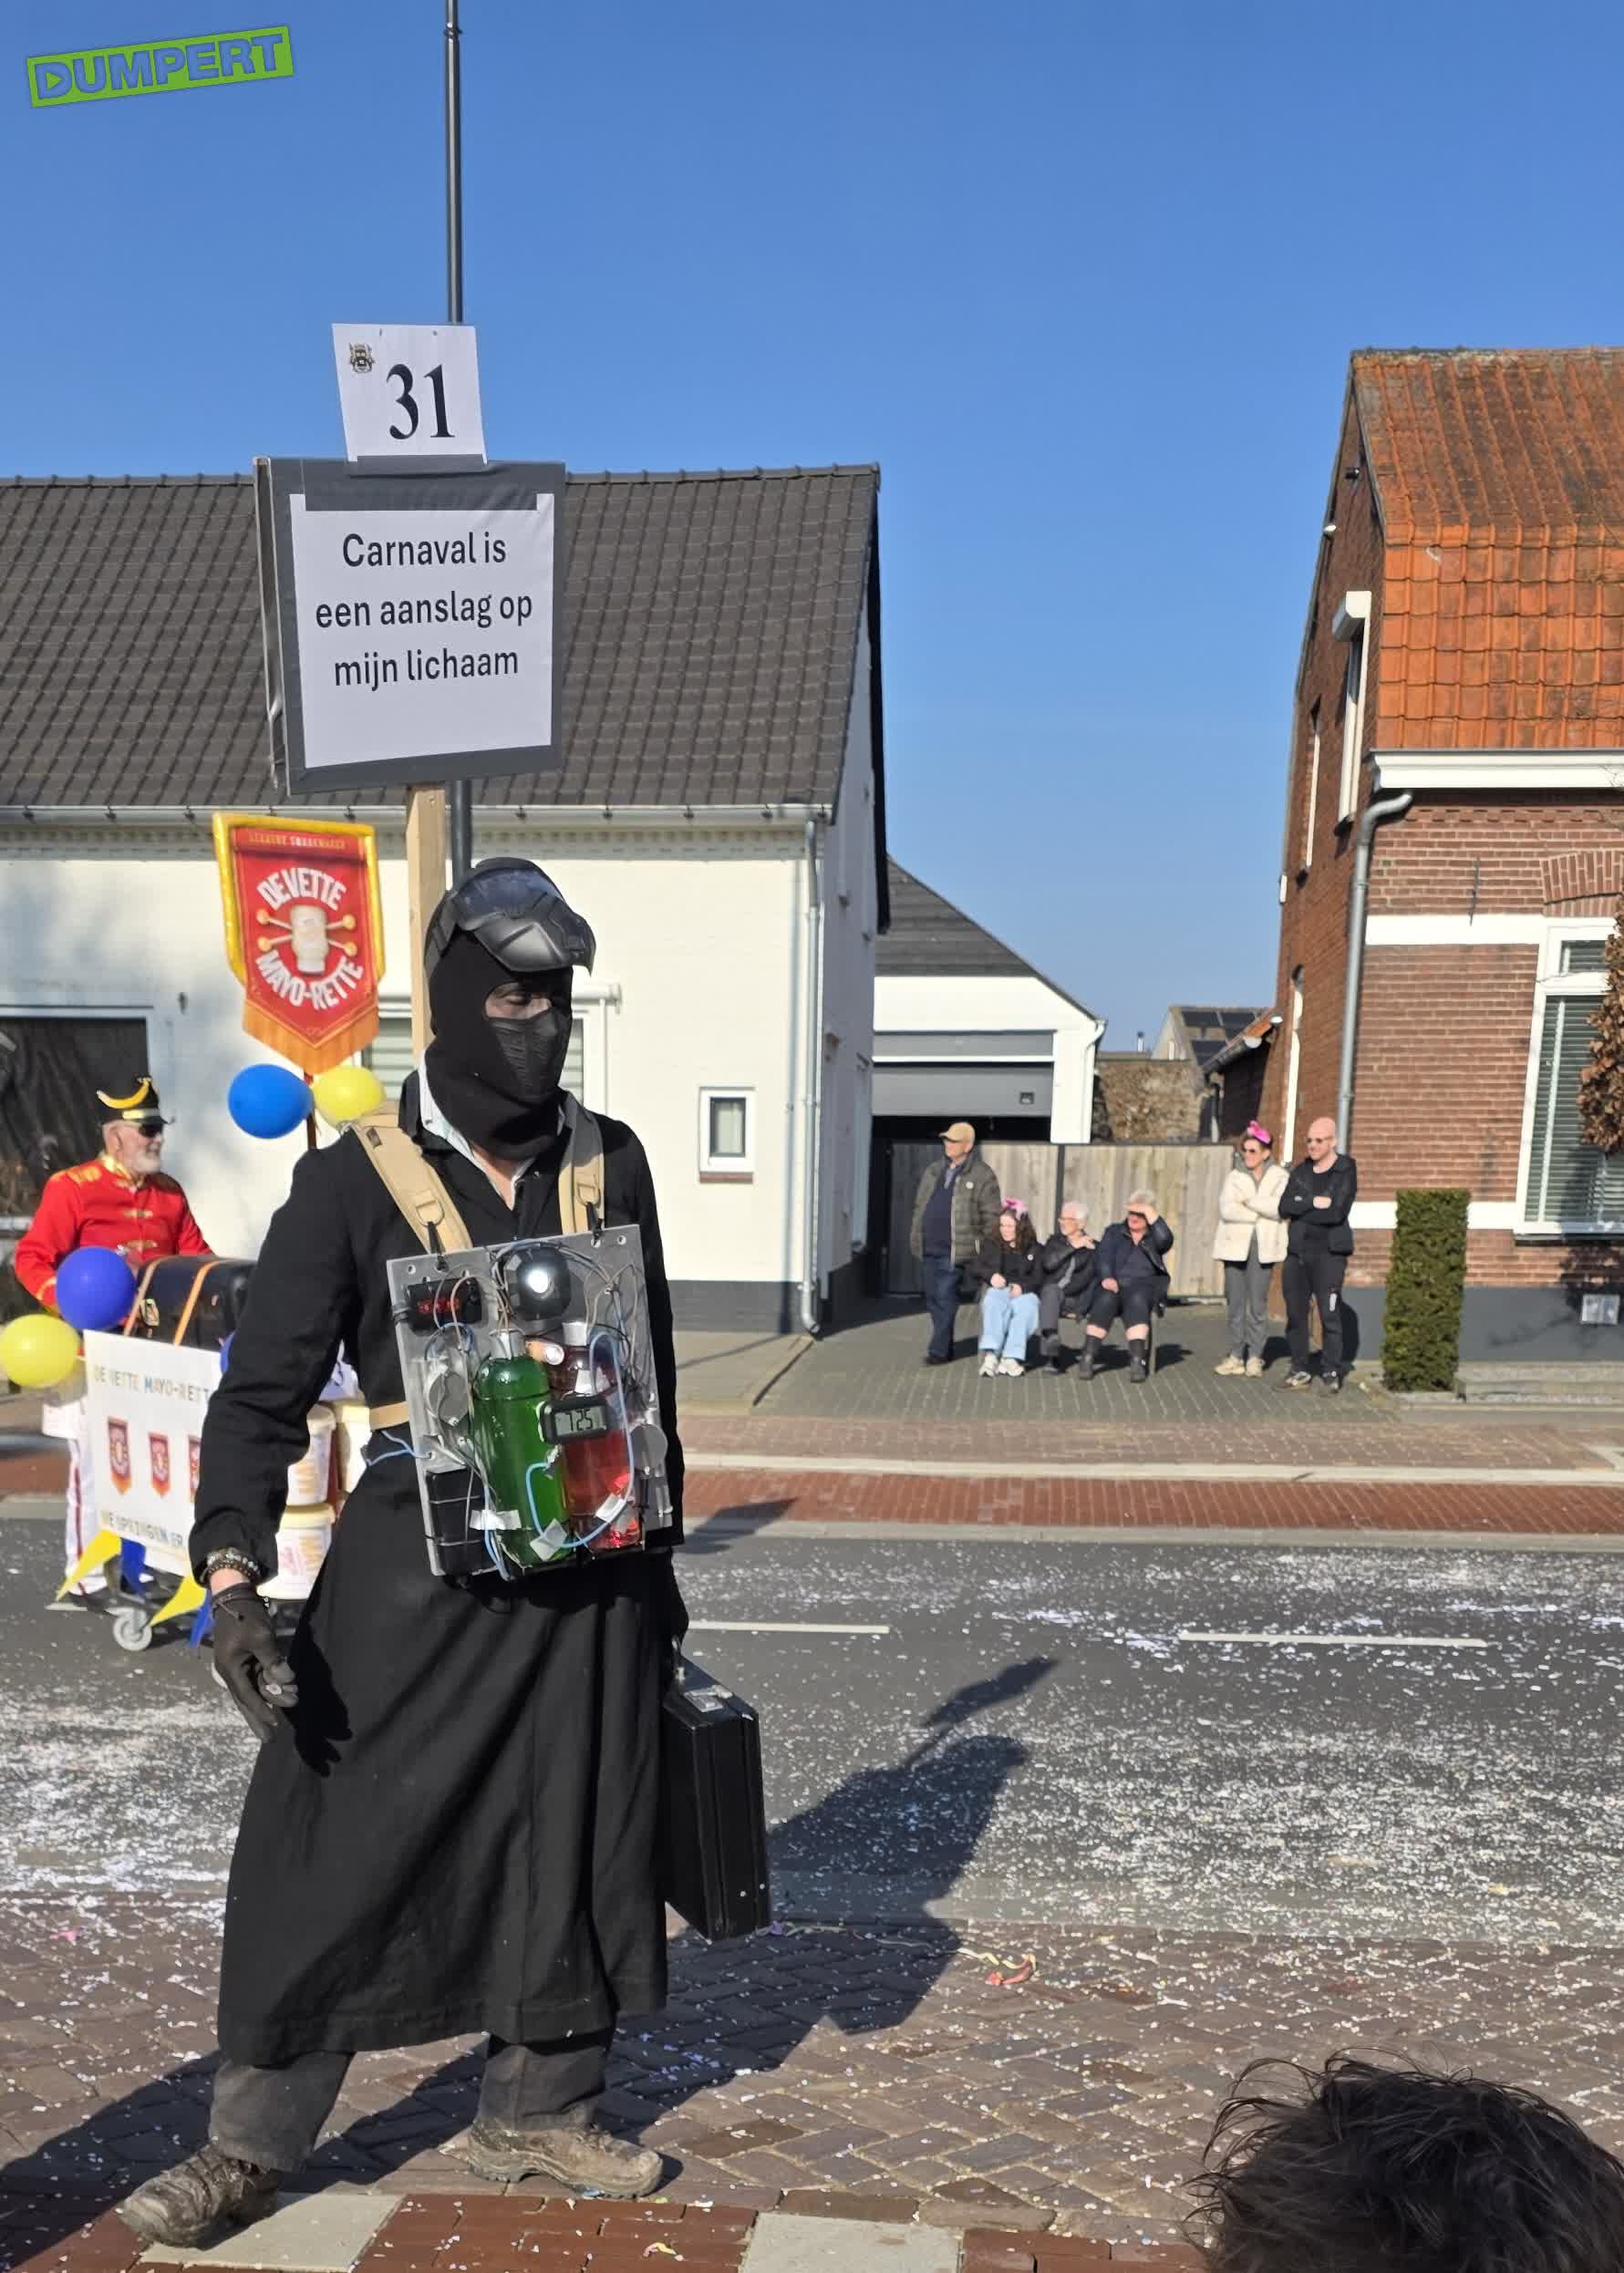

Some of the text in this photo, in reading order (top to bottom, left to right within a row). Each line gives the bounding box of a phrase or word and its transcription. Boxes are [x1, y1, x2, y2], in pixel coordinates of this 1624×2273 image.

[386, 363, 456, 441] 31
[342, 531, 507, 568] Carnaval is
[315, 589, 533, 629] een aanslag op
[334, 646, 519, 692] mijn lichaam
